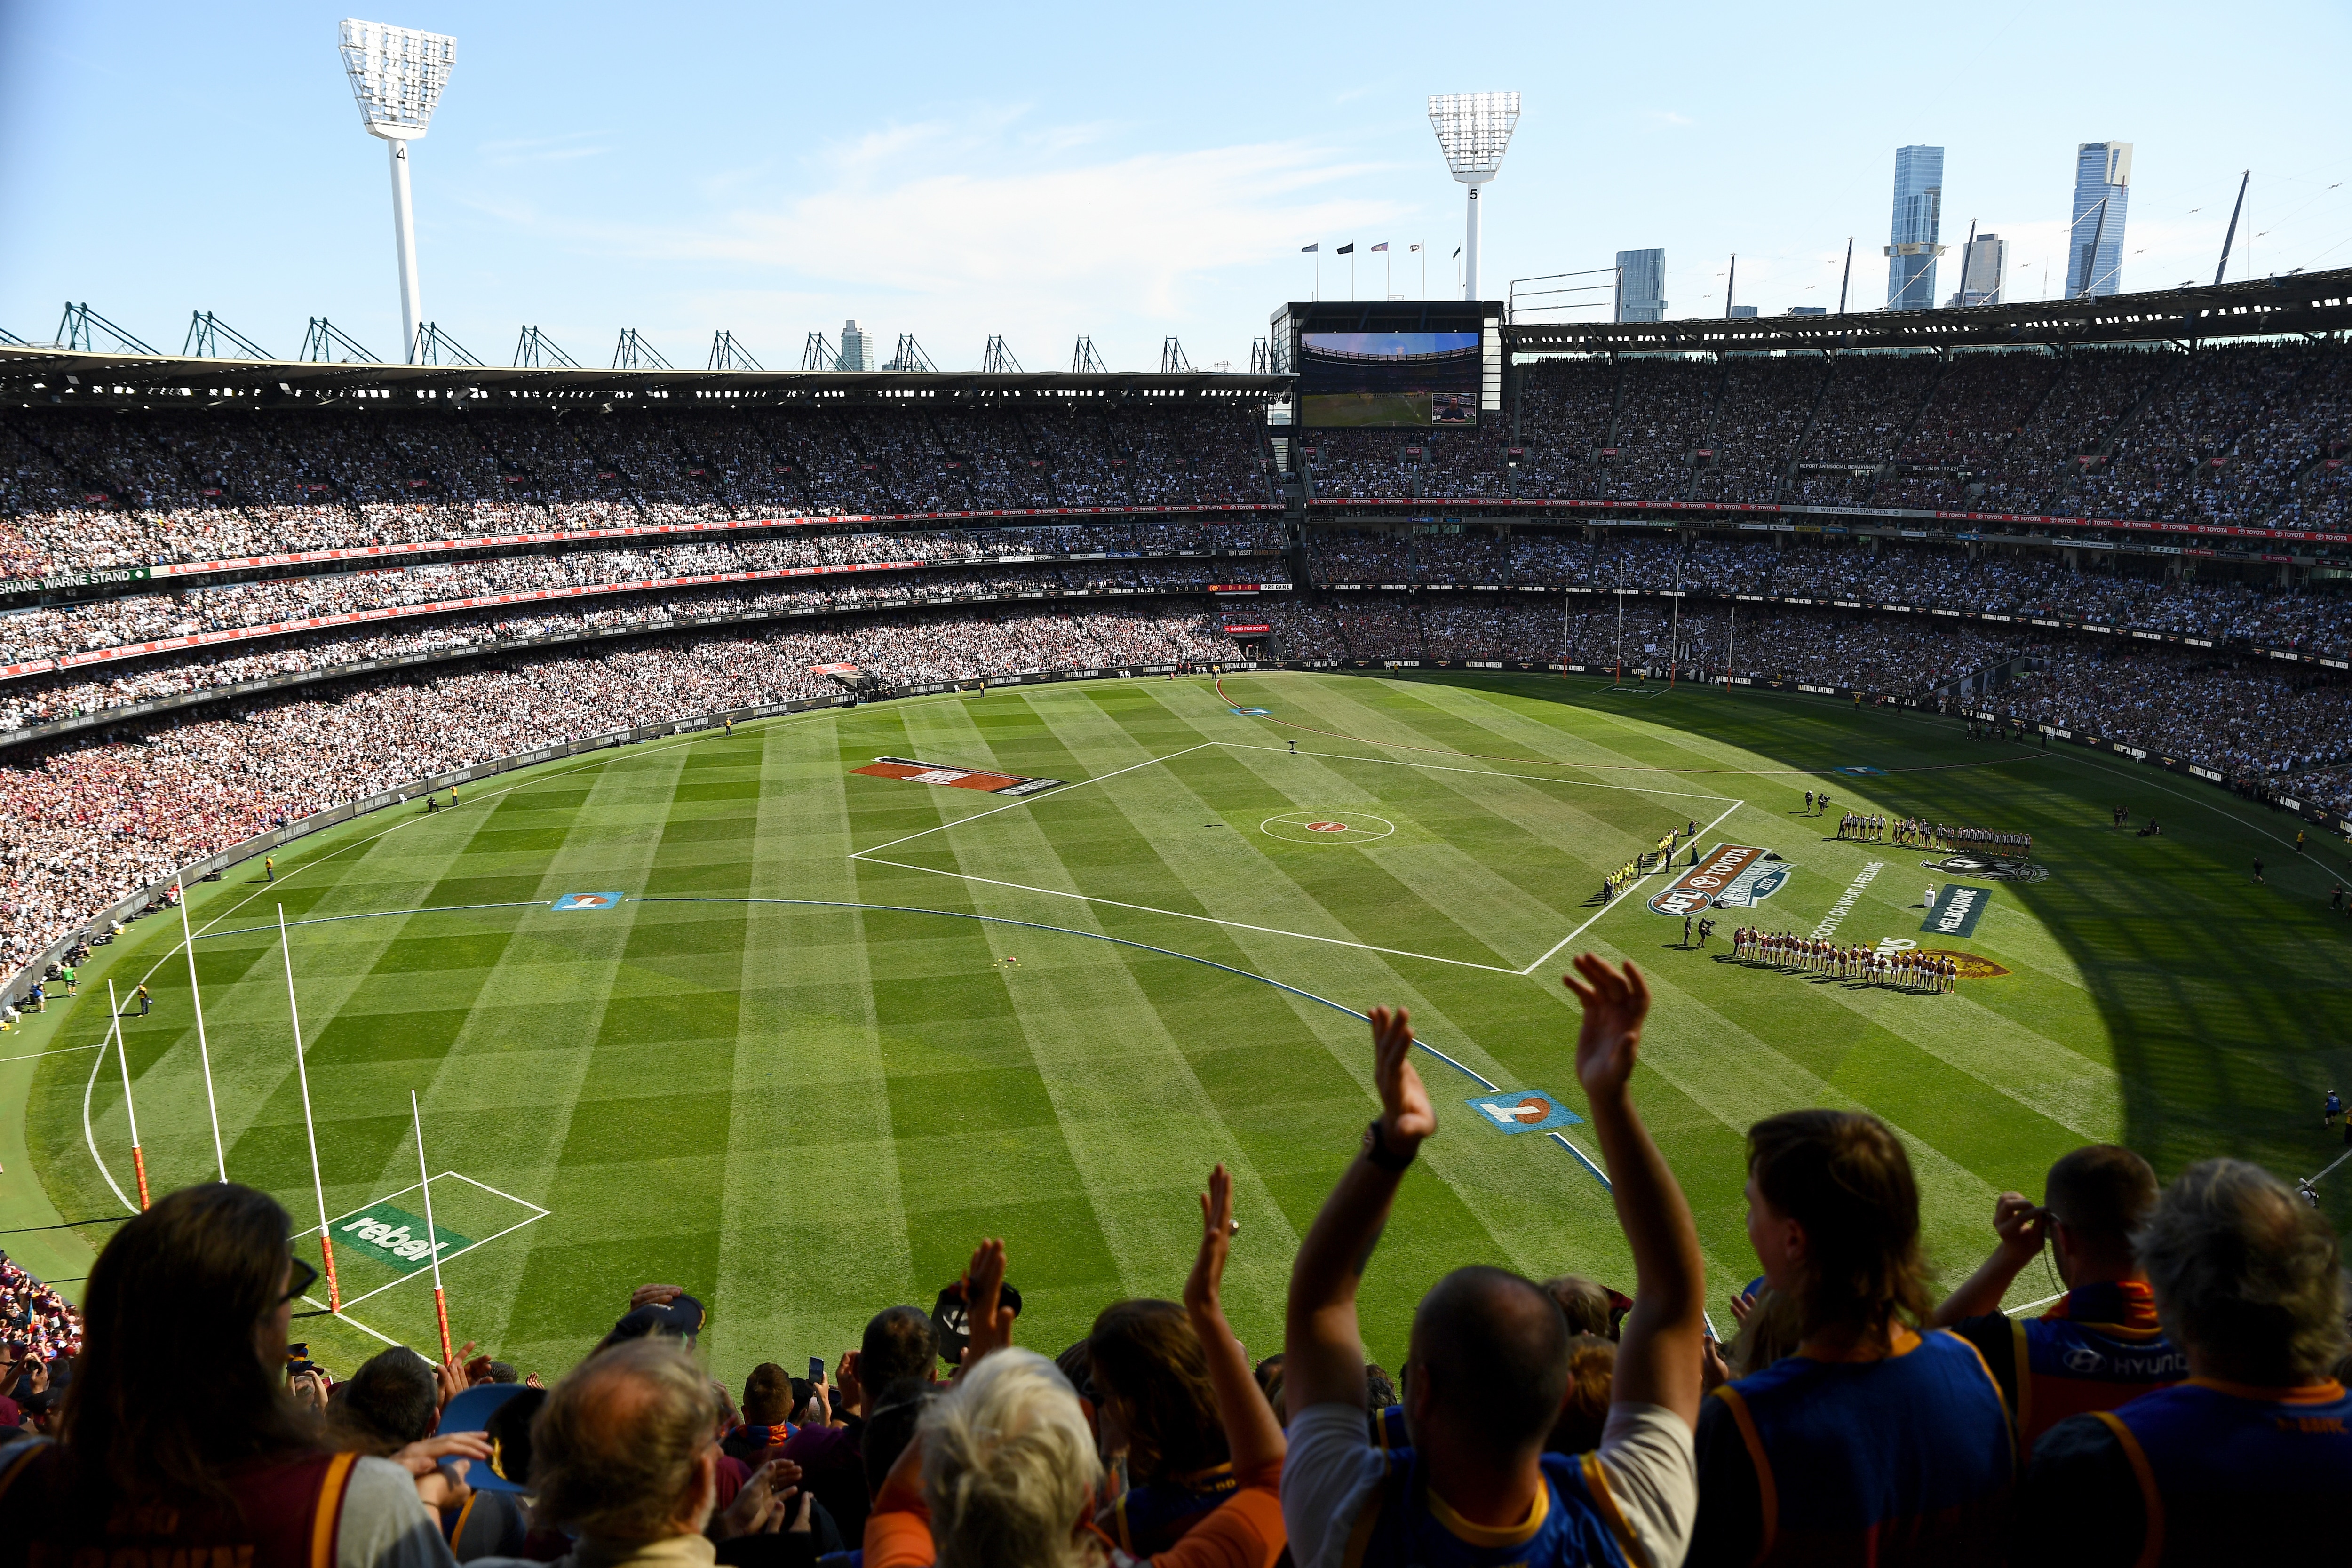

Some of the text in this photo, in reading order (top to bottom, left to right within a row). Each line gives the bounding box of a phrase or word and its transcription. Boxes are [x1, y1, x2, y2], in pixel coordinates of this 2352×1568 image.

[396, 147, 405, 162] 4
[1470, 189, 1478, 200] 5
[309, 551, 331, 560] TOYOTA
[185, 563, 209, 572] TOYOTA
[227, 558, 251, 567] TOYOTA
[43, 575, 88, 589] WARNE
[90, 570, 131, 584] STAND
[405, 605, 427, 613] TOYOTA
[289, 620, 311, 629] TOYOTA
[207, 631, 230, 641] TOYOTA
[121, 645, 146, 655] TOYOTA
[1704, 848, 1753, 875] TOYOTA
[1854, 862, 1884, 884] FEELING
[1755, 878, 1778, 890] 2023
[1836, 888, 1864, 906] WHAT
[1658, 891, 1705, 915] AFL
[1828, 906, 1851, 916] OH
[1934, 889, 1978, 933] MELBOURNE
[341, 1217, 450, 1262] rebel
